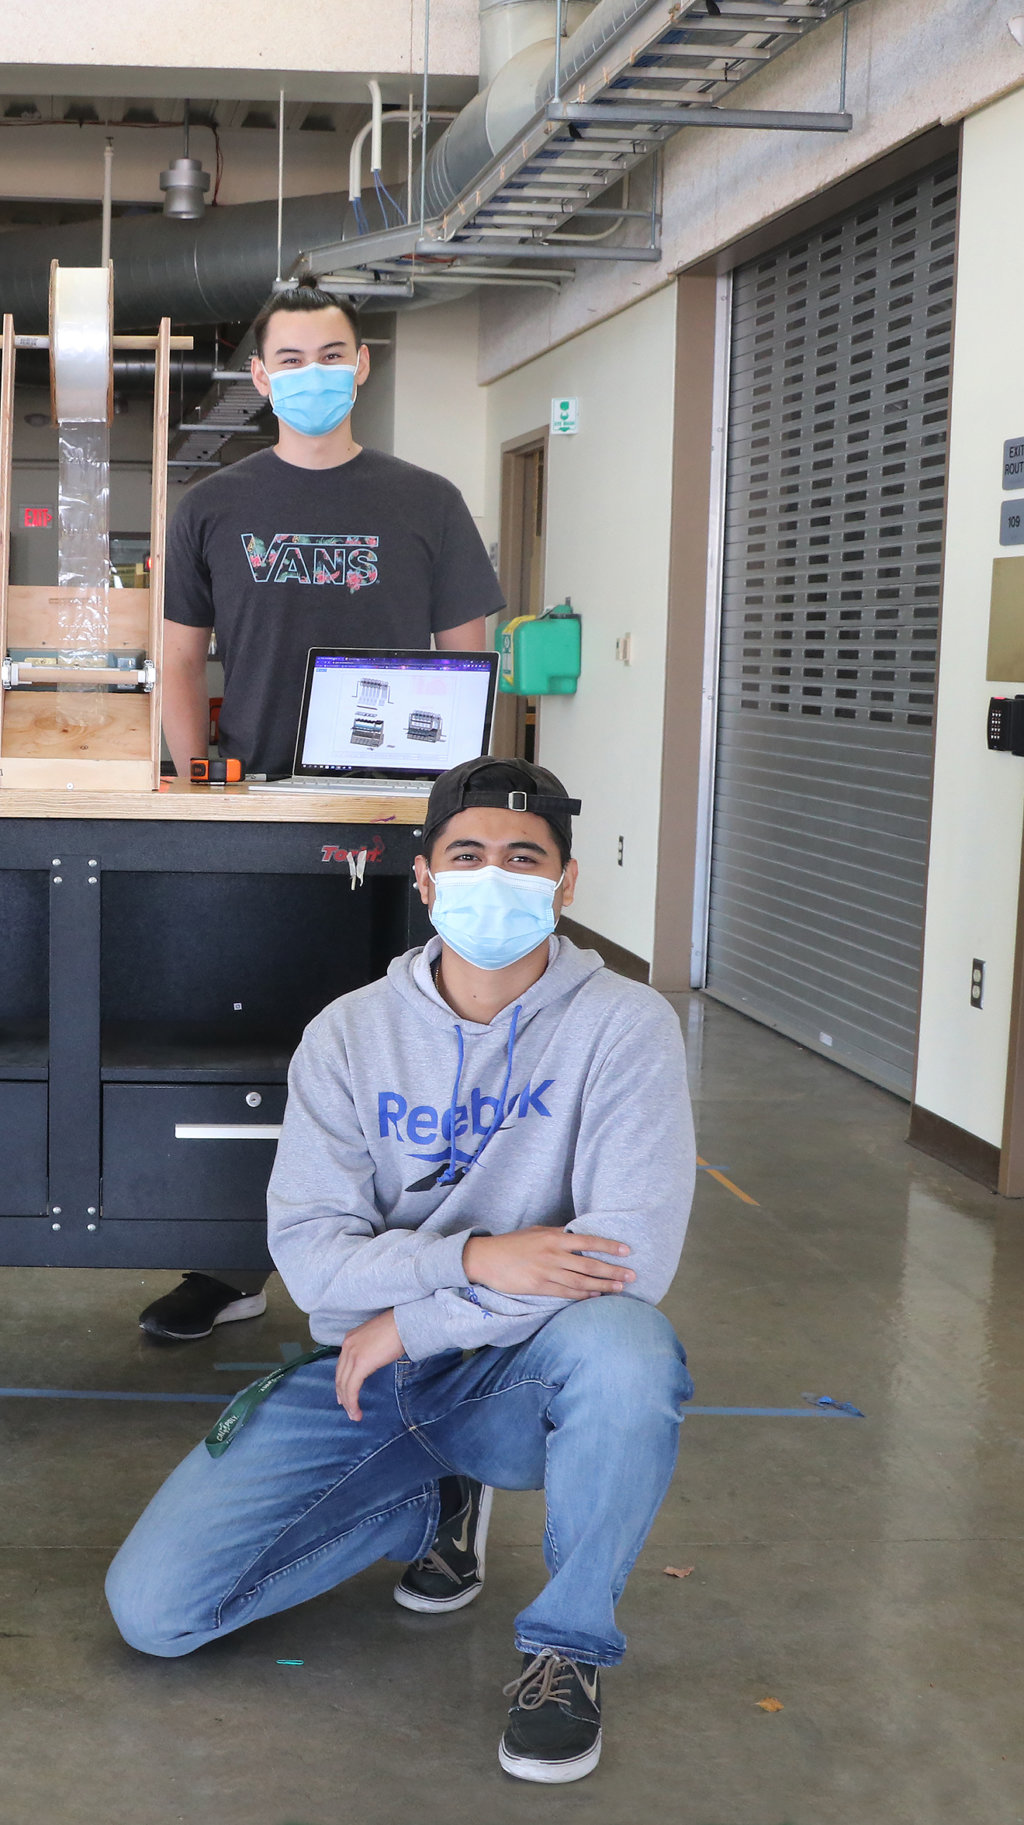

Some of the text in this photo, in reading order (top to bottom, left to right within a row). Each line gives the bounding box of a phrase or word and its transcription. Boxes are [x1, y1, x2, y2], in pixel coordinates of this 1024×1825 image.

[24, 508, 49, 527] EXIT
[1008, 516, 1020, 528] 109
[241, 533, 380, 587] VANS
